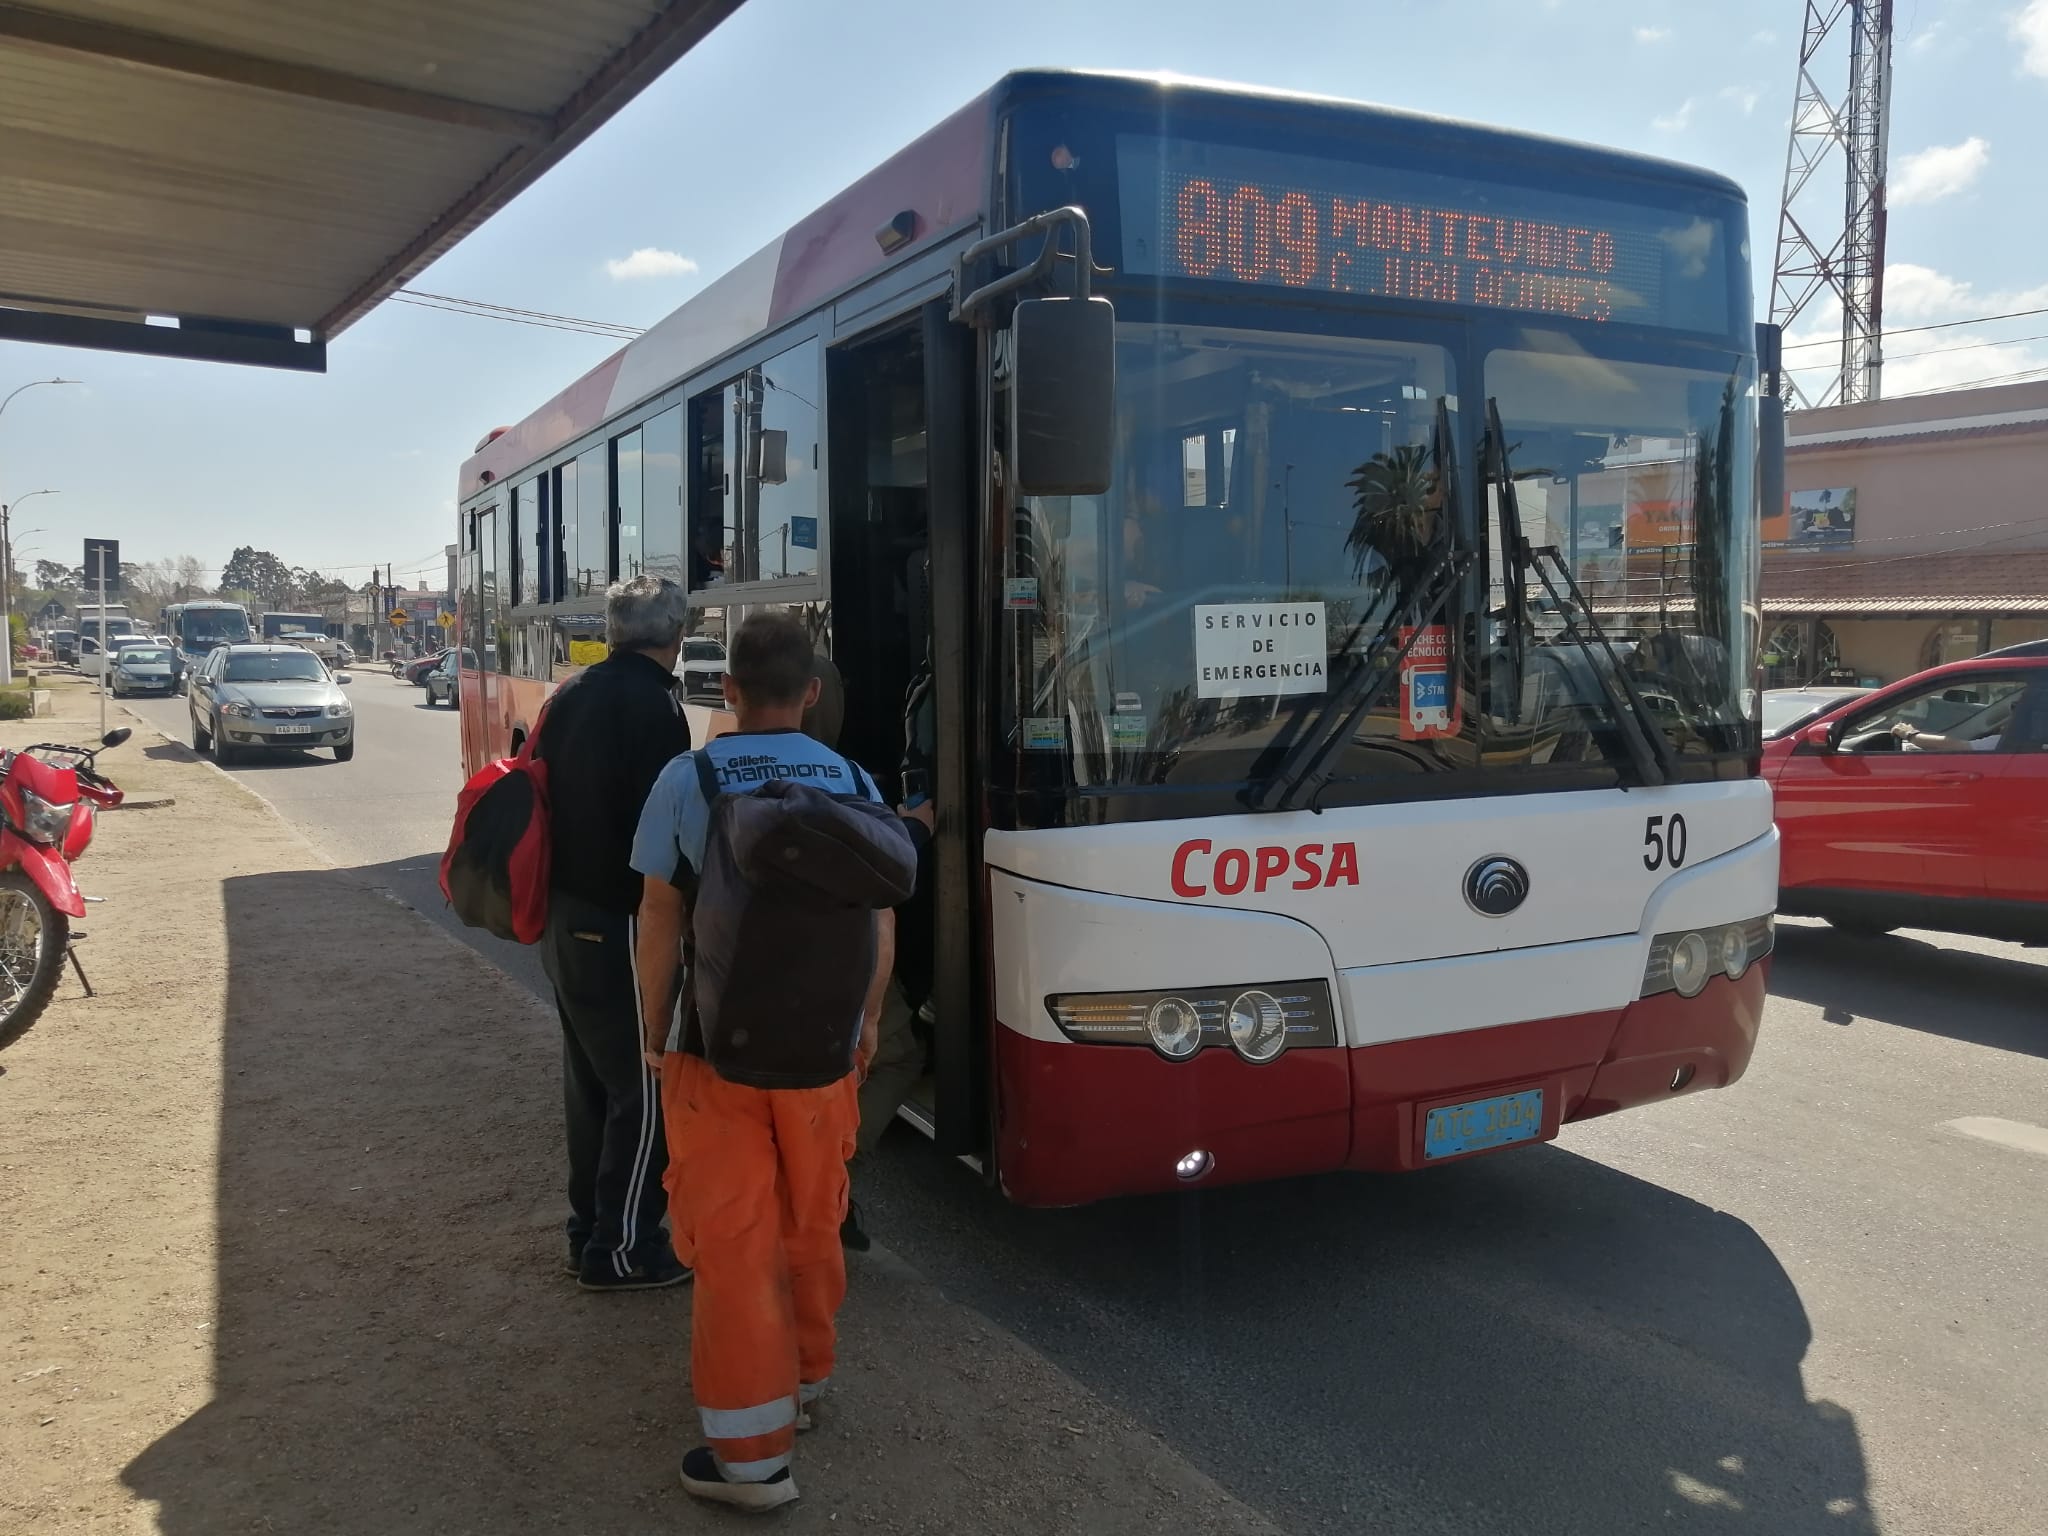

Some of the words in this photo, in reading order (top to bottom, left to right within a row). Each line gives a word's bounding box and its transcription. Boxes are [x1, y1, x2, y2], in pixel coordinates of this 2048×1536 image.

[1176, 179, 1318, 287] 809
[1332, 196, 1616, 275] MONTEVIDEO
[1204, 612, 1317, 630] SERVICIO
[1251, 639, 1275, 655] DE
[1202, 661, 1324, 682] EMERGENCIA
[1427, 685, 1445, 696] STM
[727, 754, 778, 769] Gillette
[1642, 812, 1688, 872] 50
